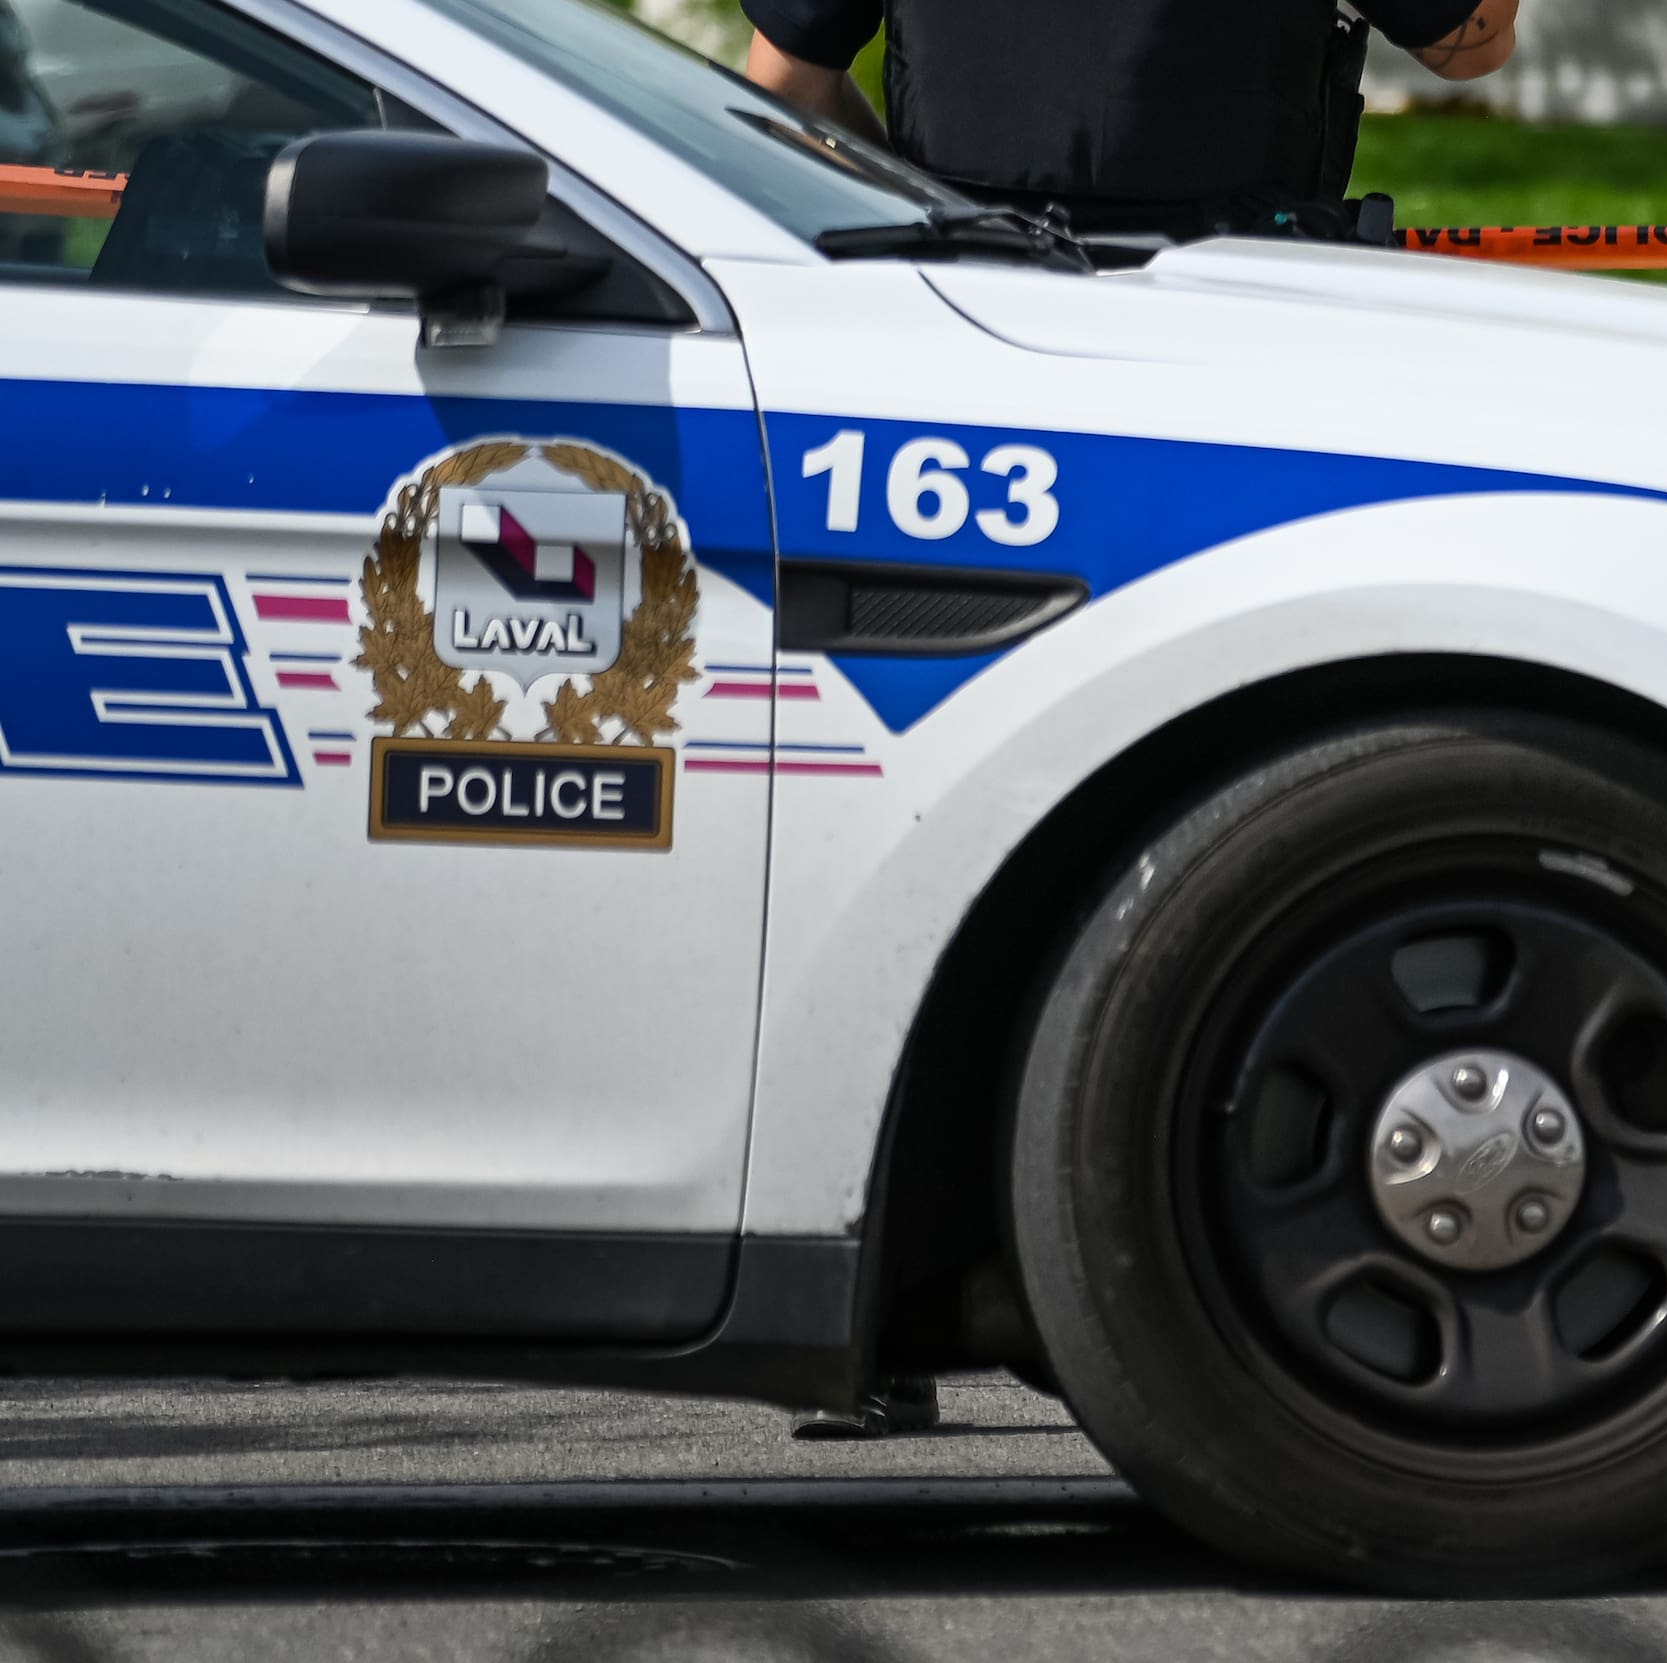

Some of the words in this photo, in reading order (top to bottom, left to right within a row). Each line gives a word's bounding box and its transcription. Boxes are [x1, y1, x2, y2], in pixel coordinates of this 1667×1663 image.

[802, 429, 1060, 547] 163
[454, 608, 596, 655] LAVAL
[419, 767, 625, 821] POLICE
